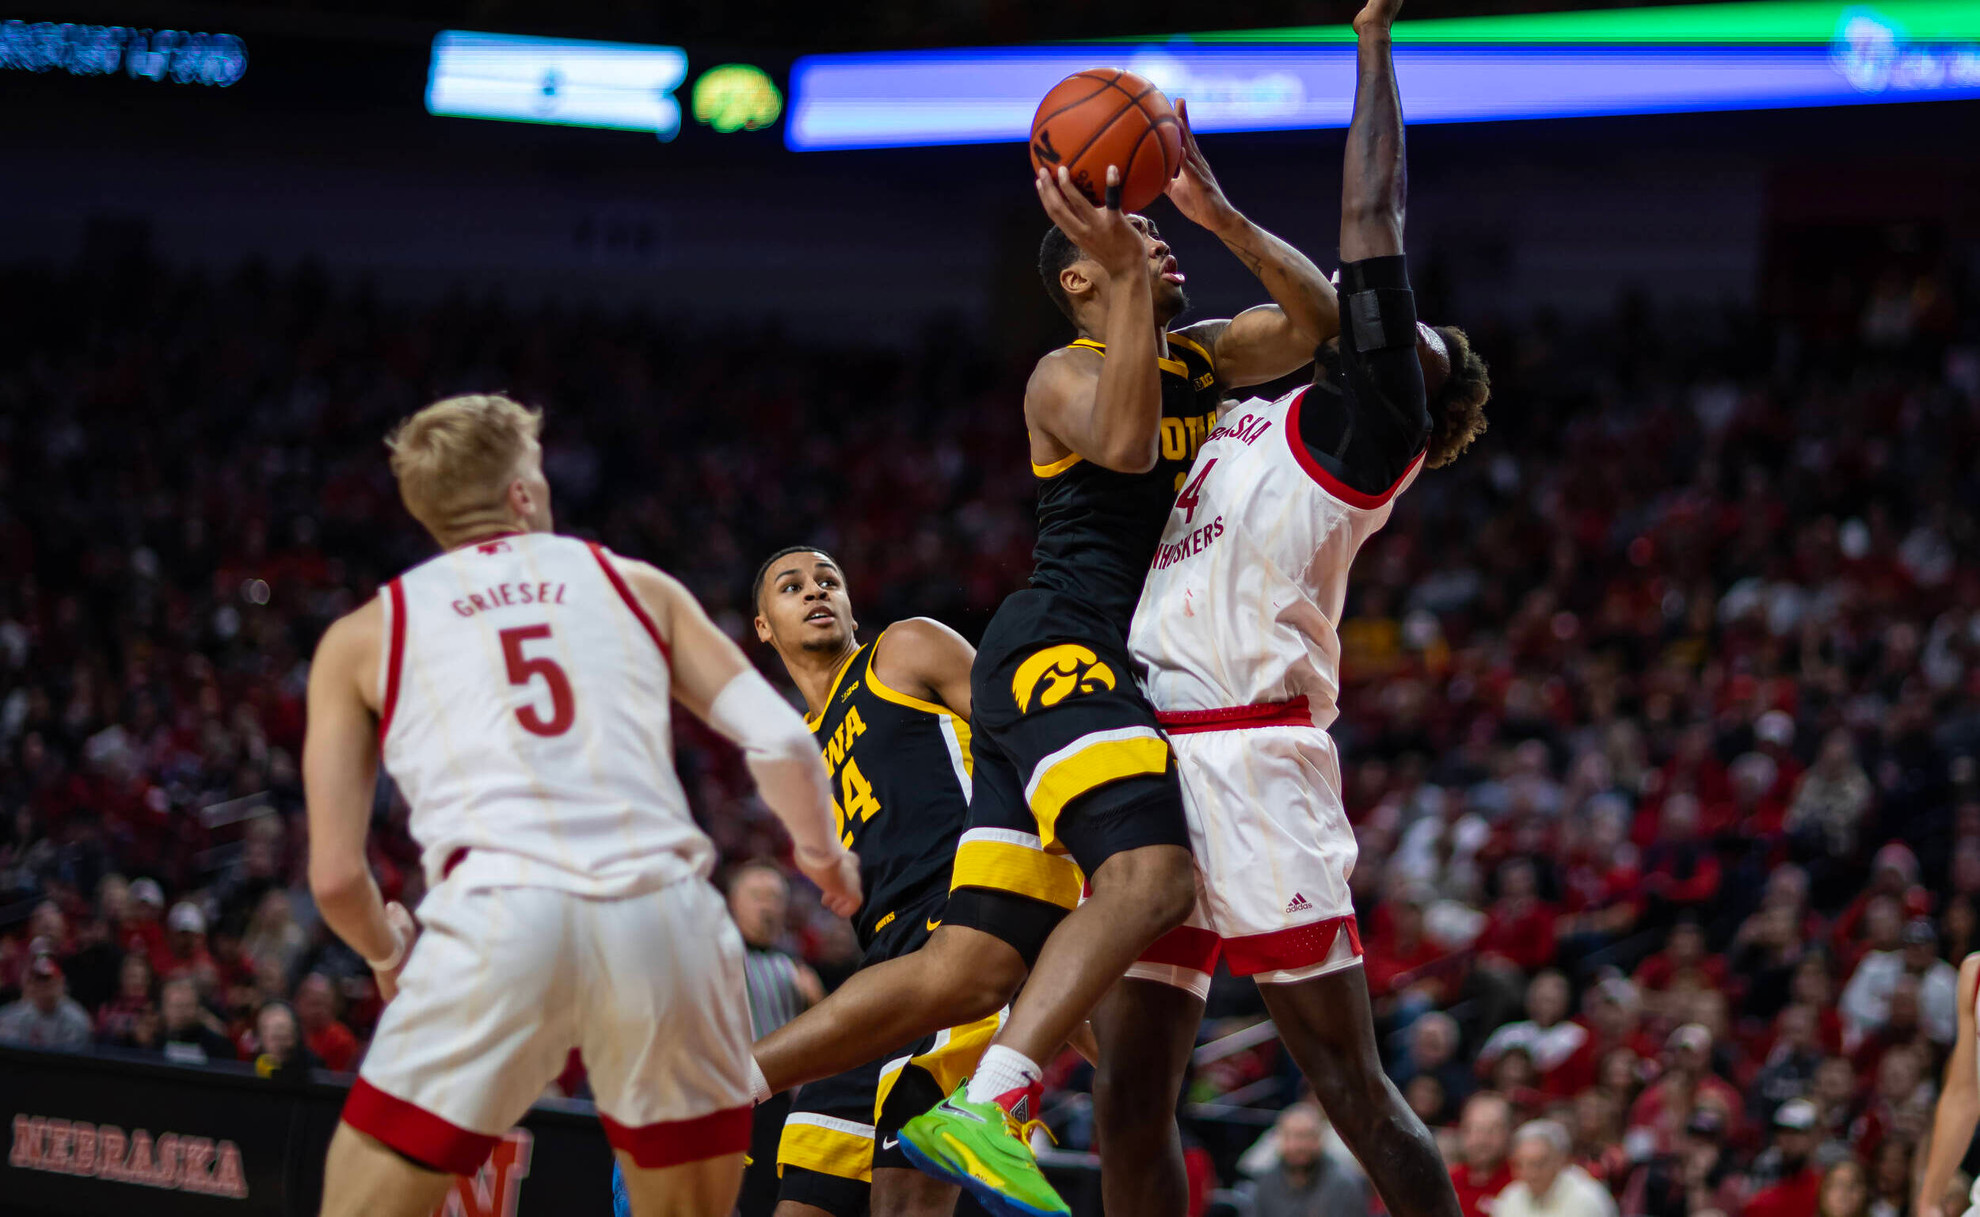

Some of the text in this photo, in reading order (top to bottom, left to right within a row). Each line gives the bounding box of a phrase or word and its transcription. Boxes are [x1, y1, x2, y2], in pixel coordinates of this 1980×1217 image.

[1175, 458, 1219, 524] 4
[452, 582, 567, 618] GRIESEL
[498, 622, 576, 738] 5
[1286, 902, 1313, 914] adidas
[8, 1112, 249, 1199] NEBRASKA
